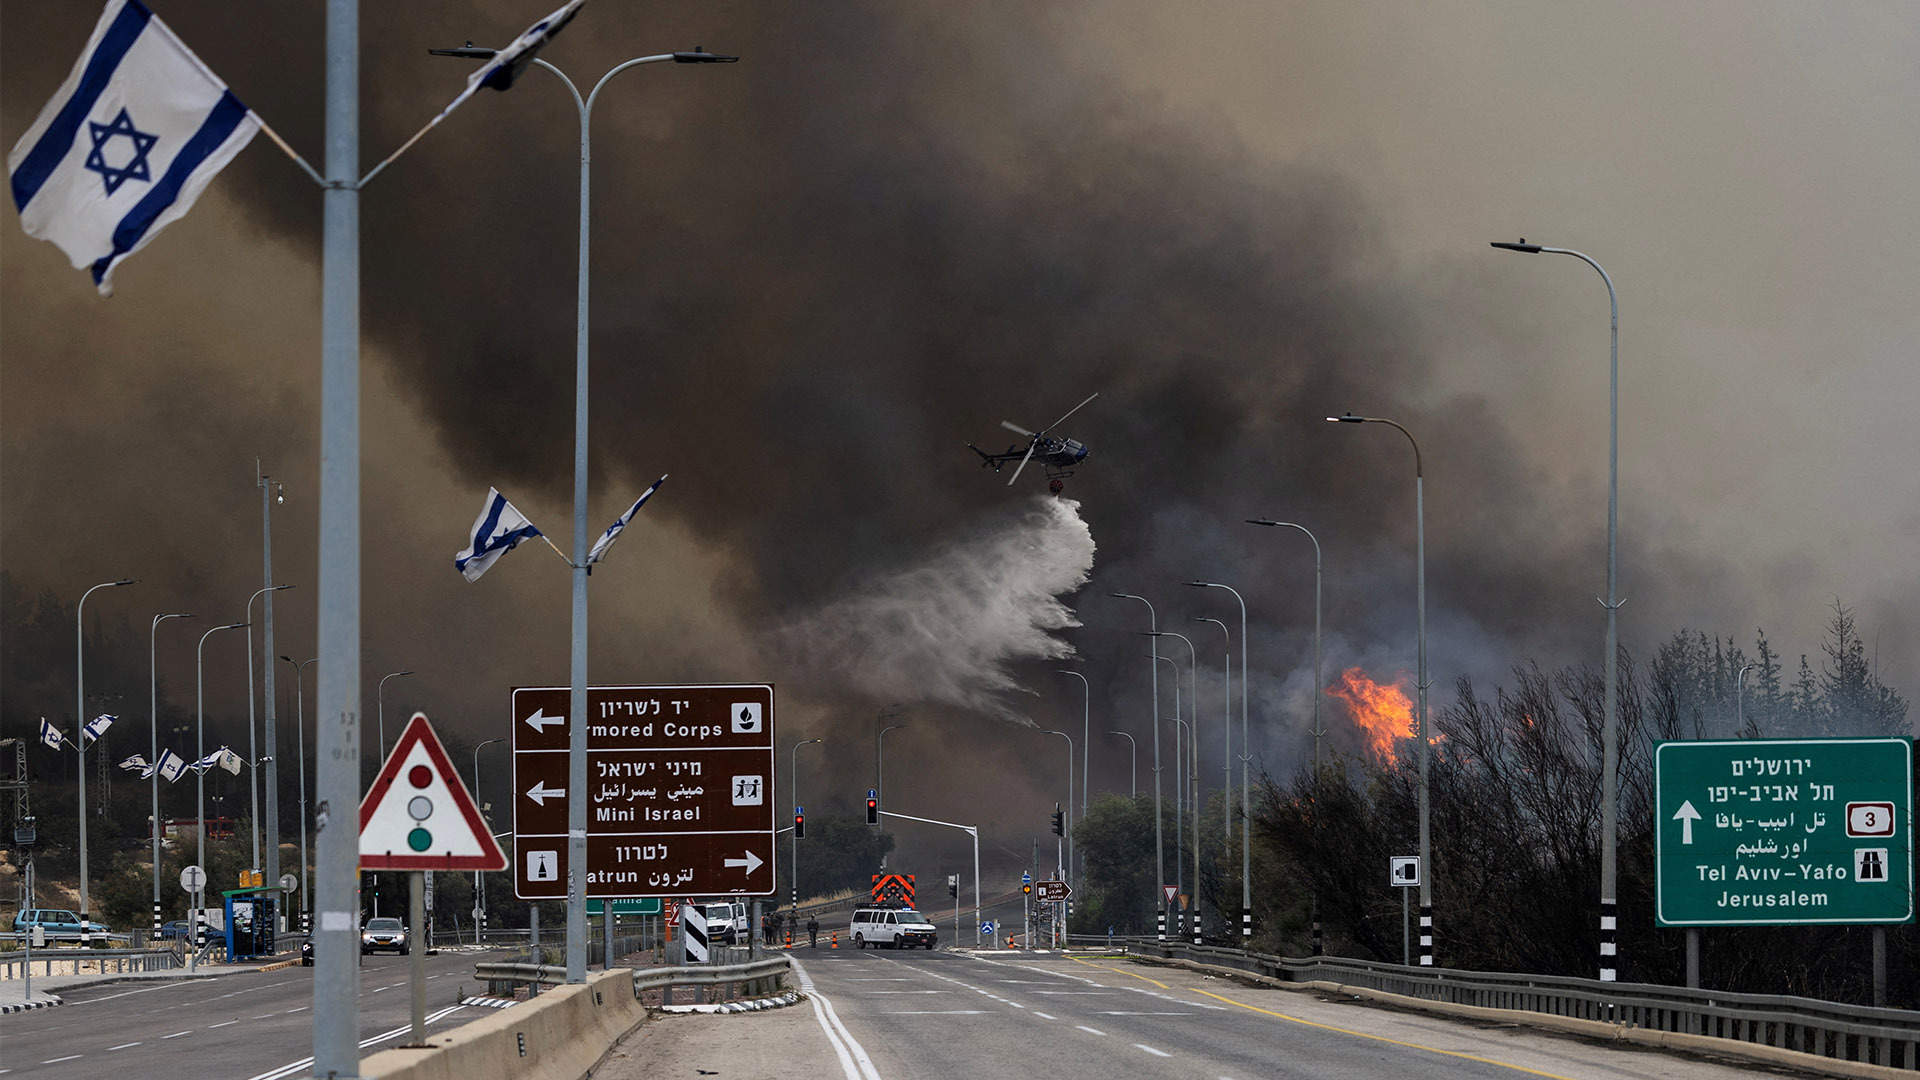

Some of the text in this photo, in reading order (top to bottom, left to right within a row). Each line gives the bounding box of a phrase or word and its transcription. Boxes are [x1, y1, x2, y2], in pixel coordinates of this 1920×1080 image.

[599, 698, 689, 718] יד לשריון
[568, 722, 722, 740] mored Corps
[597, 761, 702, 777] מיני ישראל
[1731, 757, 1811, 776] ירושלים
[593, 783, 704, 803] ميني يسرائيل
[1707, 782, 1834, 803] תל אביב-יפו
[596, 806, 700, 822] Mini Israel
[1805, 812, 1826, 834] تل
[1865, 811, 1876, 828] 3
[615, 843, 668, 863] לטרון
[1735, 838, 1807, 860] اورشليم
[586, 869, 638, 884] atrun
[648, 867, 694, 887] لترون
[1695, 865, 1726, 881] Tel
[1717, 890, 1828, 907] Jerusalem
